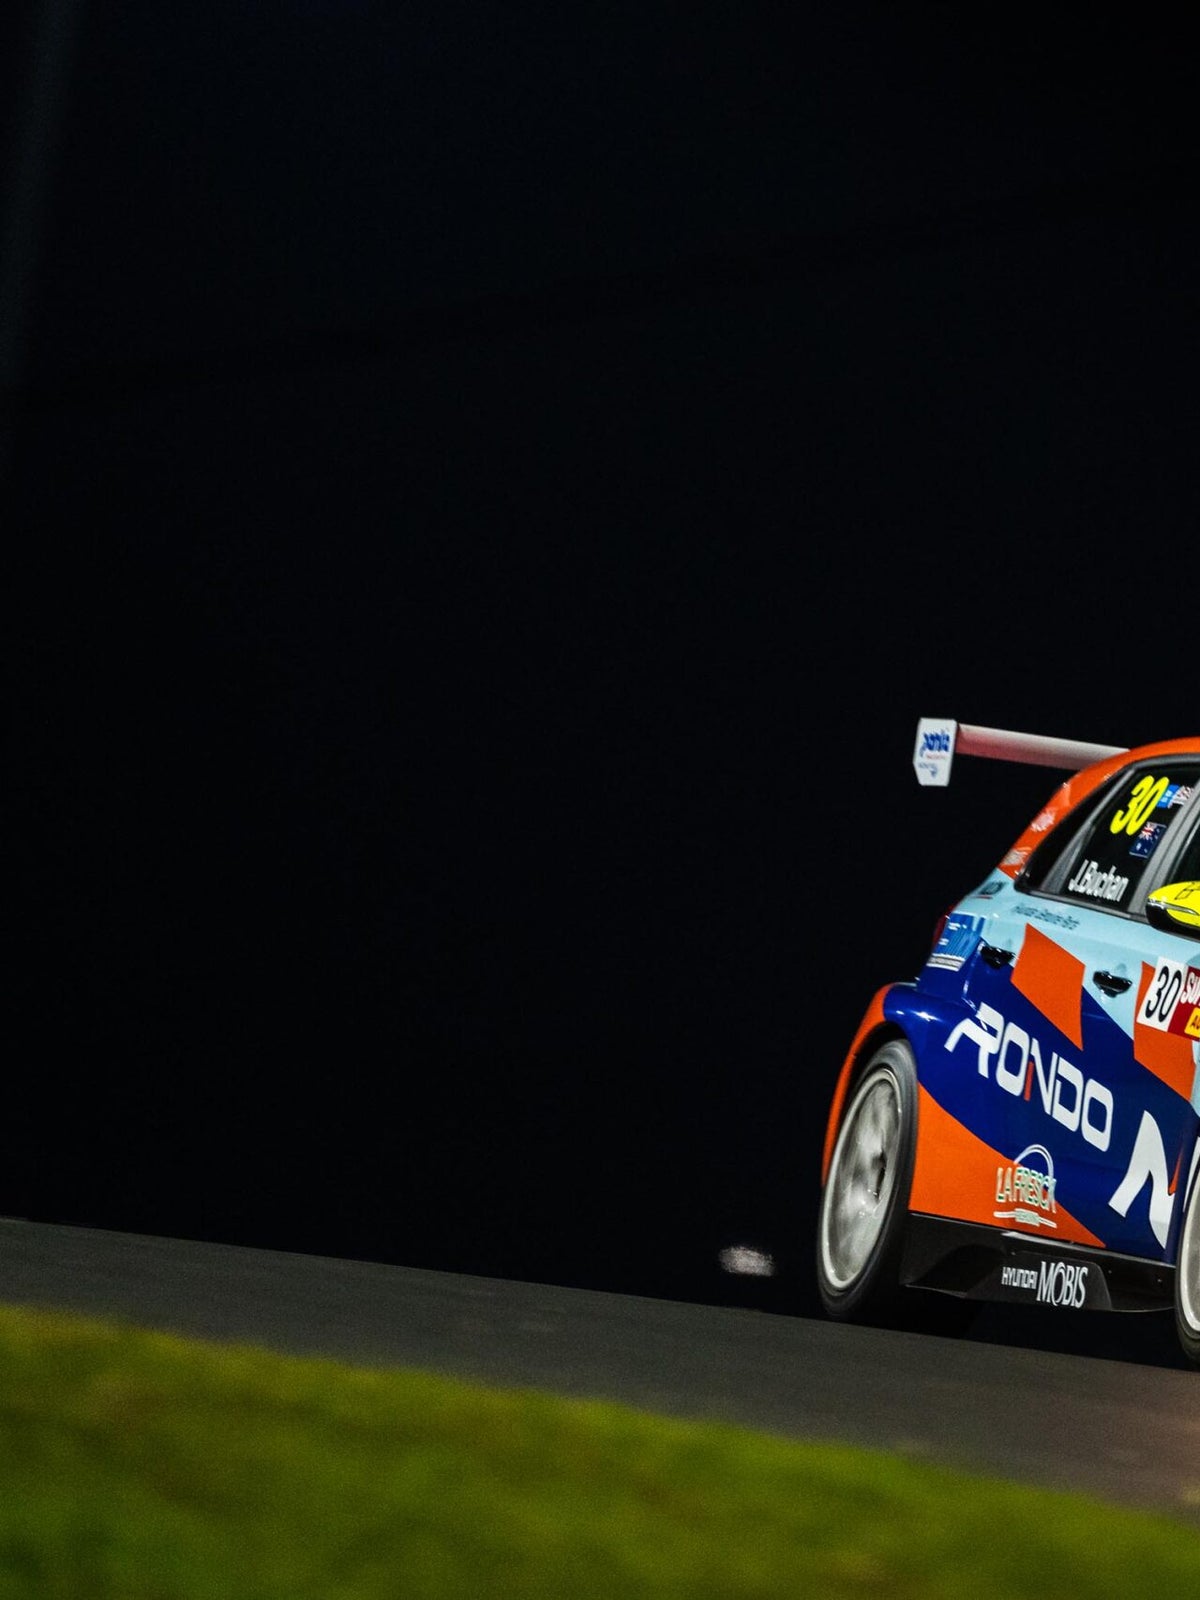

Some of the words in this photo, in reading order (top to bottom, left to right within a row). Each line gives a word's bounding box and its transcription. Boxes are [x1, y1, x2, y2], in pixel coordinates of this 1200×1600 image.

[1110, 776, 1169, 836] 30
[1145, 965, 1182, 1022] 30
[944, 1001, 1114, 1152] RONDO
[996, 1167, 1012, 1202] LA
[1001, 1266, 1038, 1290] HYUNDAI
[1036, 1261, 1088, 1308] MOBIS
